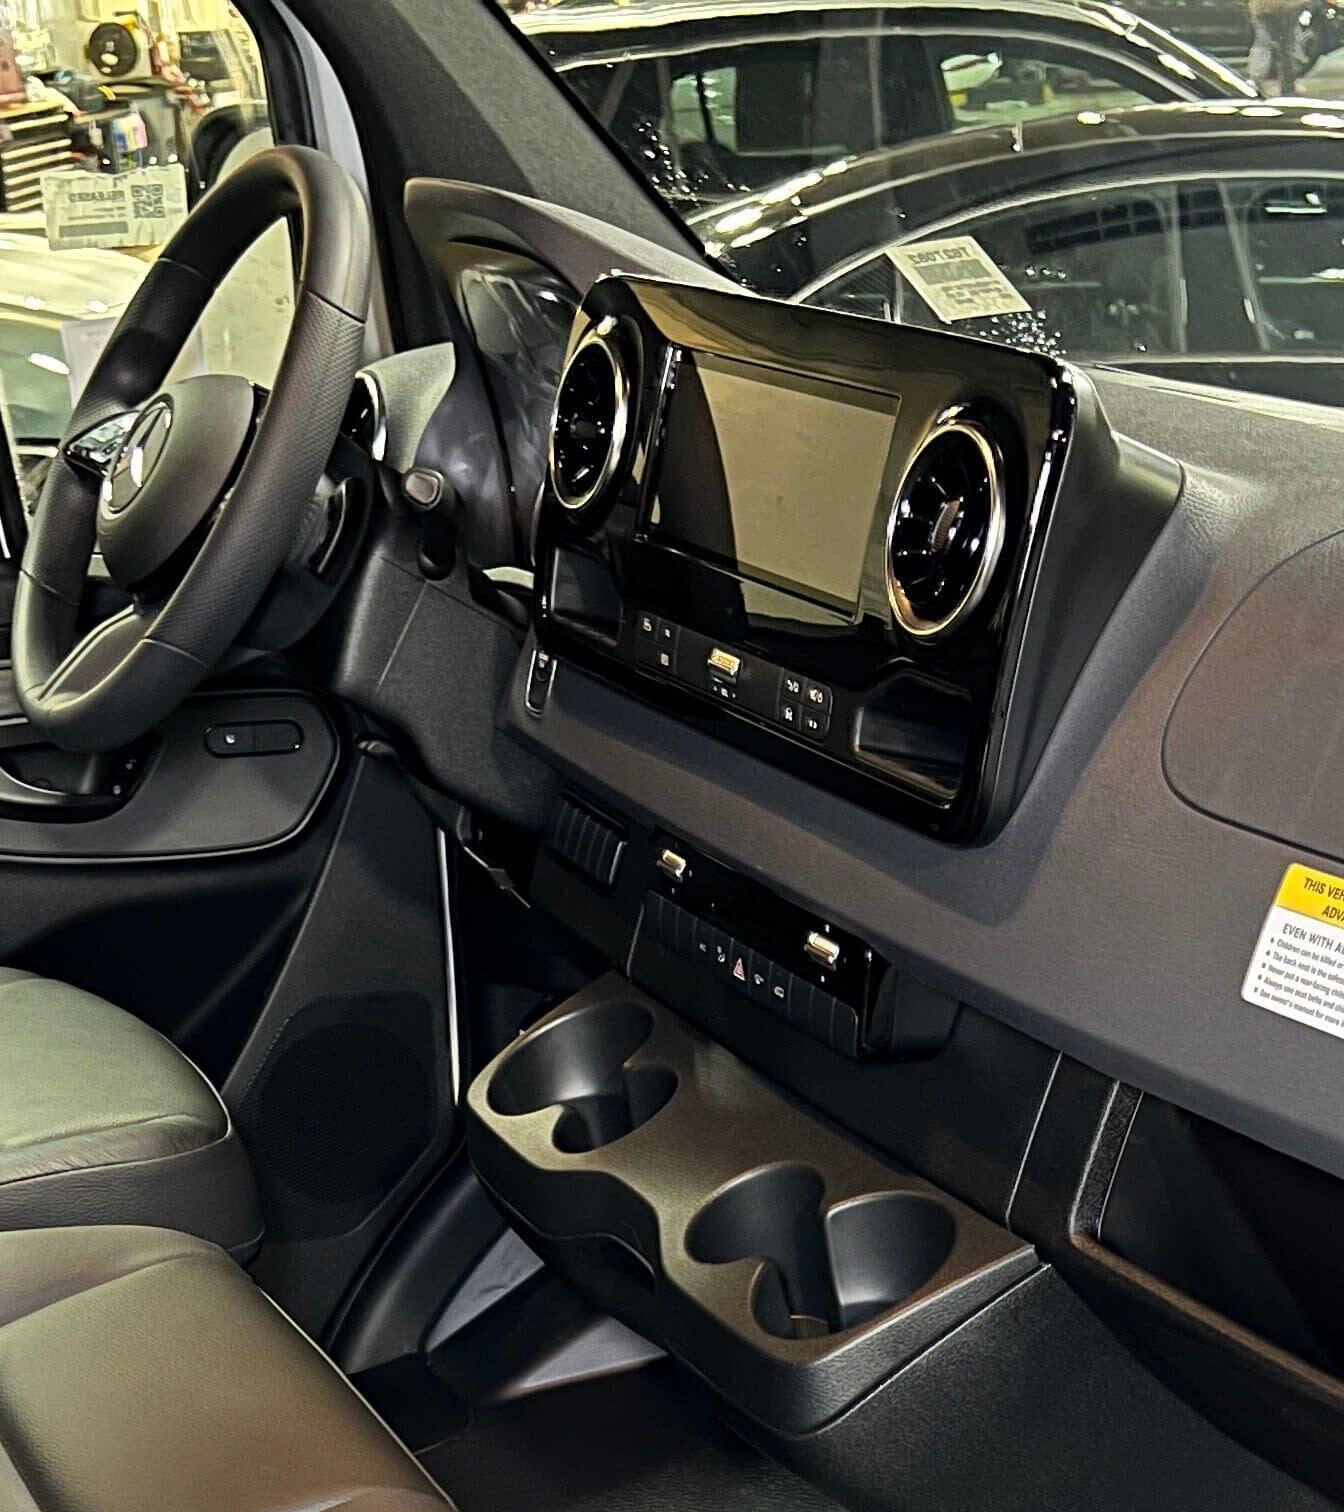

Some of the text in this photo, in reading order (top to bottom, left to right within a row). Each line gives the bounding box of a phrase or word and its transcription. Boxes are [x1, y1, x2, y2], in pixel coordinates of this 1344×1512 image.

[1303, 876, 1326, 894] THIS
[1282, 922, 1307, 940] EVEN
[1308, 932, 1334, 950] WITH
[1276, 938, 1300, 953] Children
[1316, 968, 1326, 978] the
